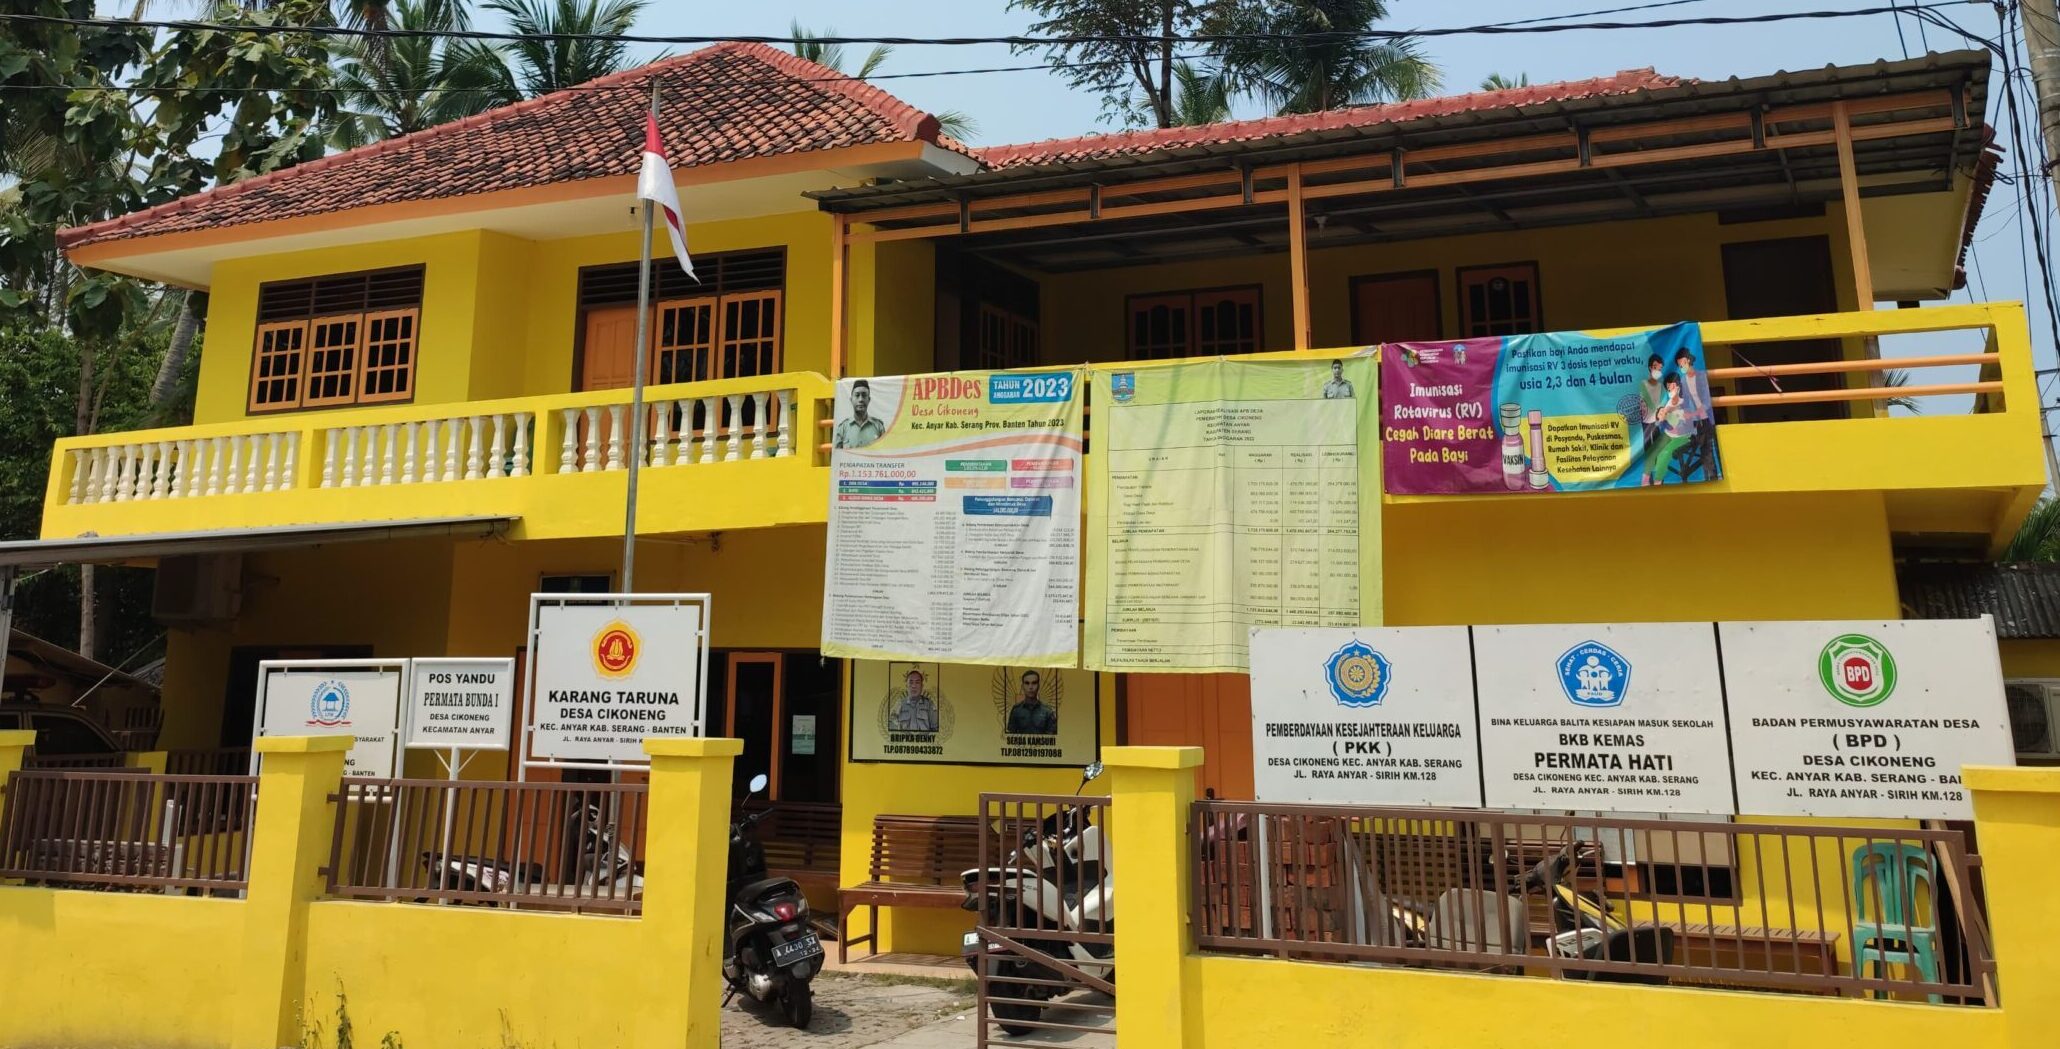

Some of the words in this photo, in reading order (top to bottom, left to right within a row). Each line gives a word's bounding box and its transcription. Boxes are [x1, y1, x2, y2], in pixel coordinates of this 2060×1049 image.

[1512, 348, 1546, 358] Pastikan
[1550, 348, 1566, 359] bayi
[1567, 346, 1588, 355] Anda
[1591, 342, 1635, 354] mendapat
[1547, 362, 1558, 370] RV
[1560, 361, 1566, 370] 3
[1568, 360, 1588, 369] dosis
[1590, 358, 1612, 369] tepat
[1614, 356, 1644, 366] waktu,
[994, 381, 1020, 390] TAHUN
[1520, 378, 1542, 390] usia
[1546, 376, 1562, 390] 2,3
[1566, 376, 1586, 388] dan
[1590, 376, 1596, 386] 4
[1600, 372, 1632, 384] bulan
[913, 376, 981, 400] APBDes
[1022, 377, 1068, 398] 2023
[1410, 383, 1462, 397] Imunisasi
[912, 405, 934, 417] Desa
[937, 404, 979, 418] Cikoneng
[1394, 404, 1452, 420] Rotavirus
[1456, 402, 1482, 420] (RV)
[912, 422, 924, 430] Kec.
[926, 420, 944, 431] Anyar
[946, 420, 958, 430] Kab.
[960, 420, 983, 431] Serang
[985, 420, 1000, 429] Prov.
[1003, 420, 1025, 428] Banten
[1028, 420, 1046, 428] Tahun
[1548, 424, 1578, 432] Dapatkan
[1386, 426, 1418, 441] Cegah
[1422, 427, 1454, 440] Diare
[1458, 426, 1494, 440] Berat
[1548, 444, 1570, 452] Rumah
[1590, 442, 1608, 450] Klinik
[1410, 448, 1439, 463] Pada
[1442, 448, 1468, 463] Bayi
[1502, 454, 1524, 466] VAKSIN
[429, 674, 452, 684] POS
[456, 674, 495, 684] YANDU
[1846, 666, 1870, 682] BPD
[424, 692, 463, 706] PERMATA
[466, 693, 493, 707] BUNDA
[495, 694, 498, 707] I
[549, 690, 611, 703] KARANG
[617, 692, 679, 704] TARUNA
[560, 708, 593, 719] DESA
[598, 708, 666, 720] CIKONENG
[590, 724, 609, 732] KAB.
[612, 725, 645, 733] SERANG
[652, 726, 686, 734] BANTEN
[1593, 719, 1635, 727] KESIAPAN
[1638, 719, 1669, 727] MASUK
[1672, 720, 1714, 728] SEKOLAH
[1752, 718, 1796, 727] BADAN
[1800, 718, 1939, 728] PERMUSYAWARATAN
[1944, 719, 1980, 729] DESA
[1266, 723, 1333, 737] PEMBERDAYAAN
[1336, 723, 1411, 737] KESEJAHTERAAN
[1413, 724, 1461, 738] KELUARGA
[1559, 734, 1588, 746] BKB
[1594, 734, 1644, 747] KEMAS
[1846, 735, 1887, 747] BPD
[1345, 742, 1381, 754] PKK
[1293, 758, 1339, 767] CIKONENG
[1342, 759, 1363, 767] KEC.
[1366, 759, 1397, 767] ANYAR
[1400, 759, 1422, 767] KAB.
[1424, 760, 1462, 768] SERANG
[1534, 752, 1622, 769] PERMATA
[1628, 754, 1673, 770] HATI
[1803, 756, 1845, 766] DESA
[1850, 756, 1936, 767] CIKONENG
[1376, 772, 1400, 780] SIRIH
[1403, 772, 1436, 781] KM.128
[1538, 774, 1581, 782] CIKONENG
[1584, 774, 1605, 782] KEC.
[1608, 774, 1636, 783] ANYAR
[1639, 775, 1660, 783] KAB.
[1663, 776, 1699, 784] SERANG
[1752, 771, 1781, 780] KEC.
[1786, 772, 1830, 781] ANYAR
[1835, 773, 1866, 782] KAB.
[1871, 773, 1926, 783] SERANG
[1787, 788, 1802, 797] JL.
[1809, 788, 1837, 798] RAYA
[1840, 789, 1878, 799] ANYAR
[1888, 790, 1918, 800] SIRIH
[1922, 790, 1962, 801] KM.128
